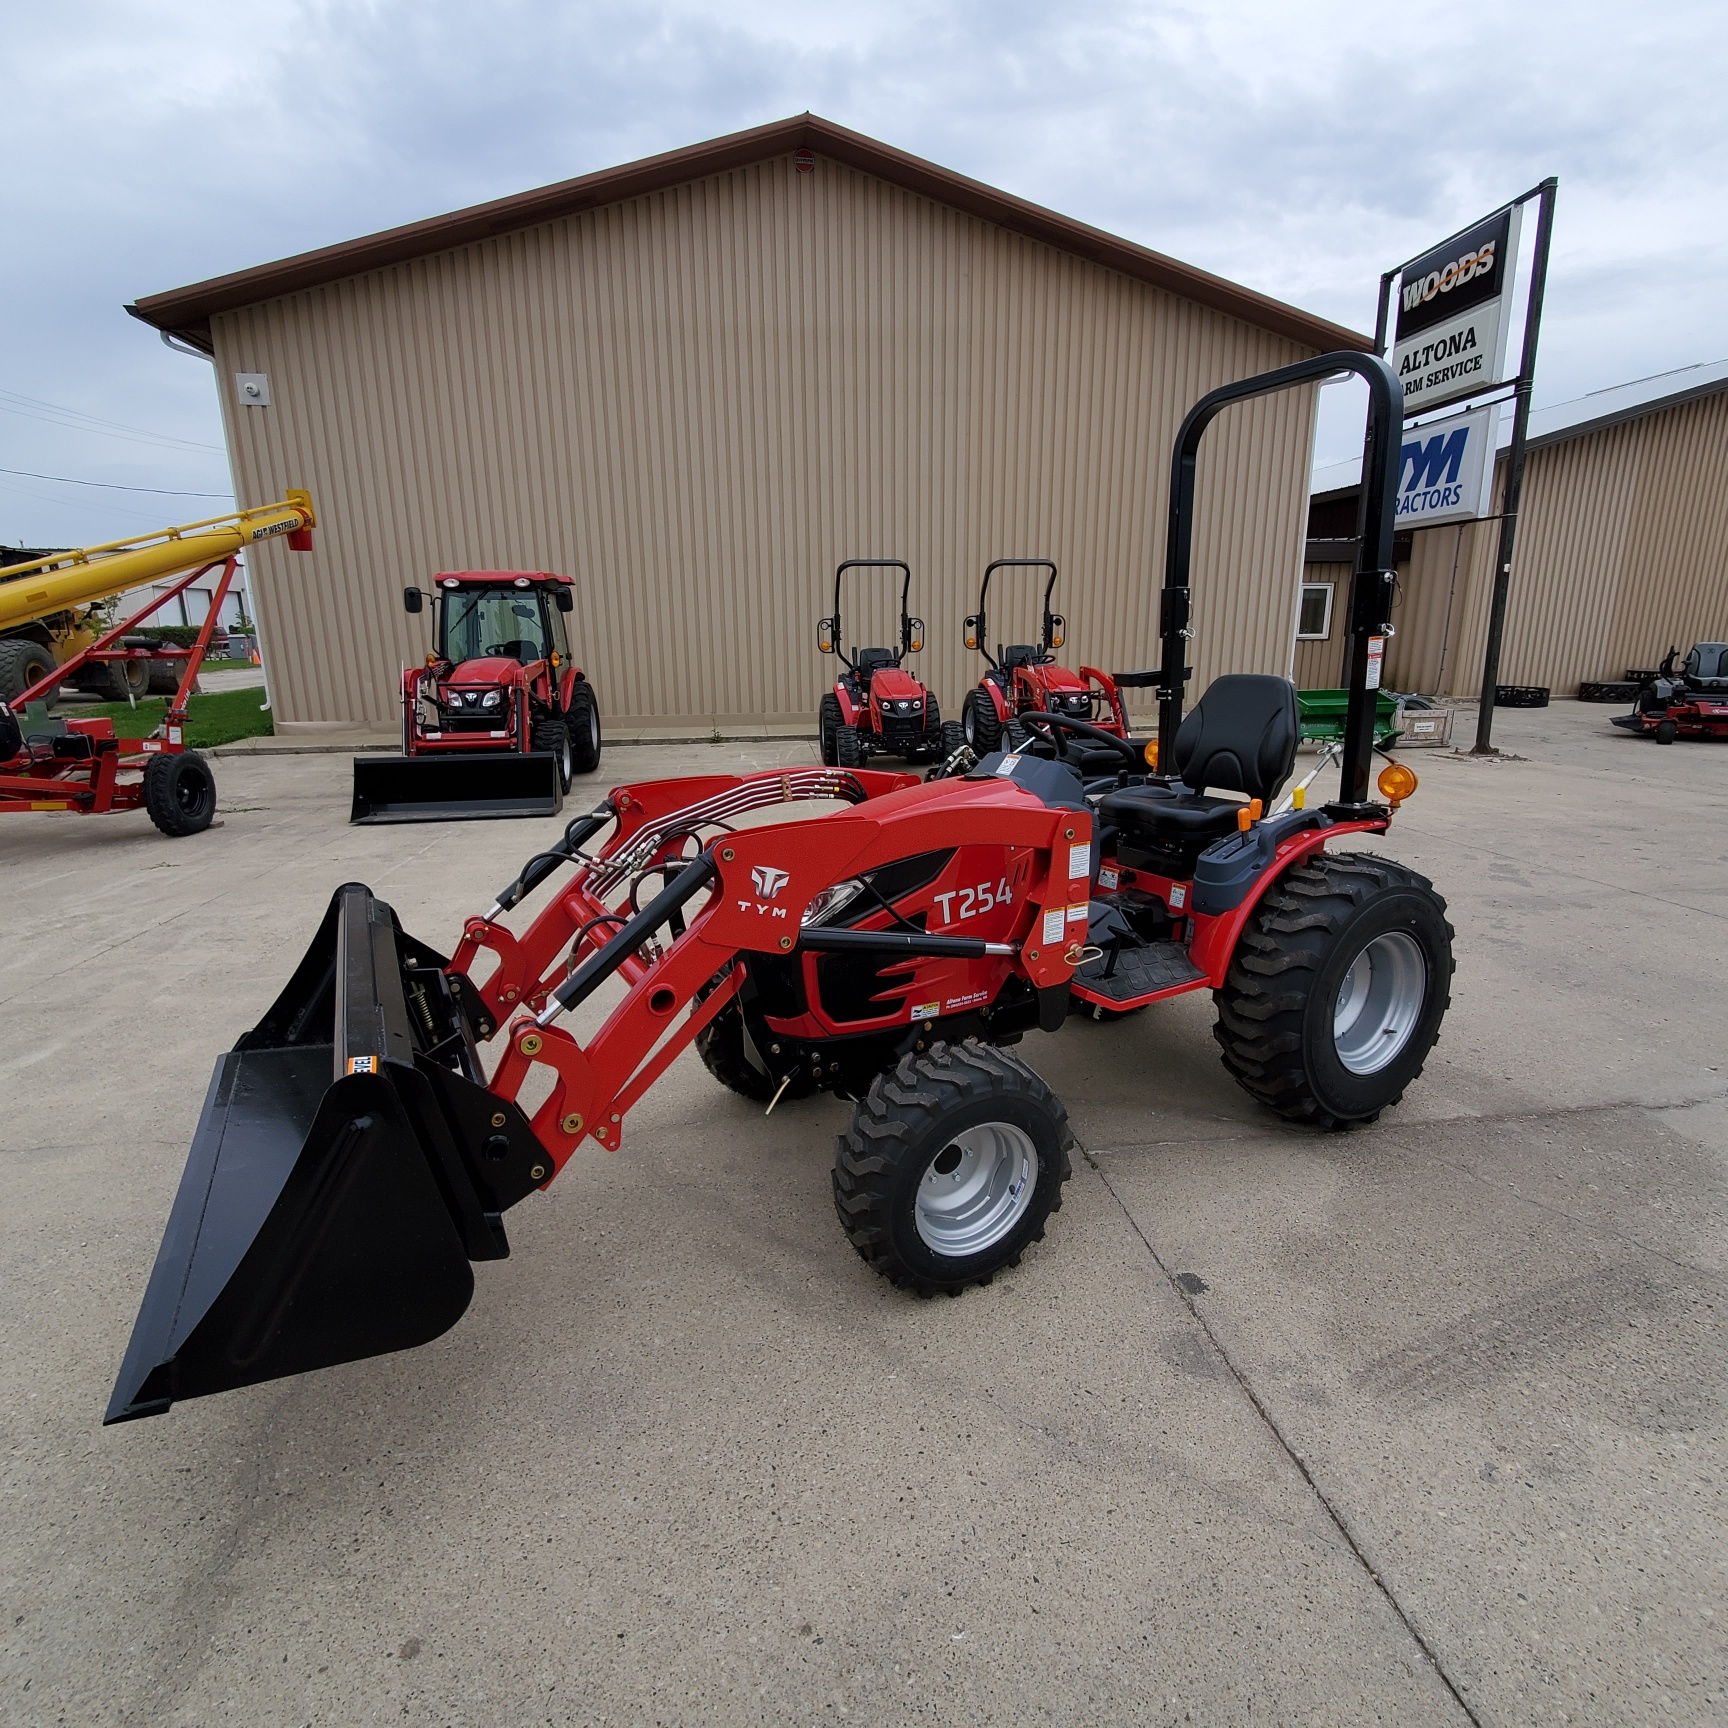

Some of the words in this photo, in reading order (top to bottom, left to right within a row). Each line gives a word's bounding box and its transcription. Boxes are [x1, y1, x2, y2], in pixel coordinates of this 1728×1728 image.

[1402, 239, 1496, 313] WOODS
[1399, 326, 1477, 377] ALTONA
[1401, 376, 1424, 397] RM
[1426, 354, 1483, 388] SERVICE
[1395, 484, 1463, 515] RACTORS
[267, 518, 299, 535] WESTFIELD
[737, 900, 787, 919] TYM
[933, 877, 1013, 924] T254
[354, 1057, 371, 1073] EVEL
